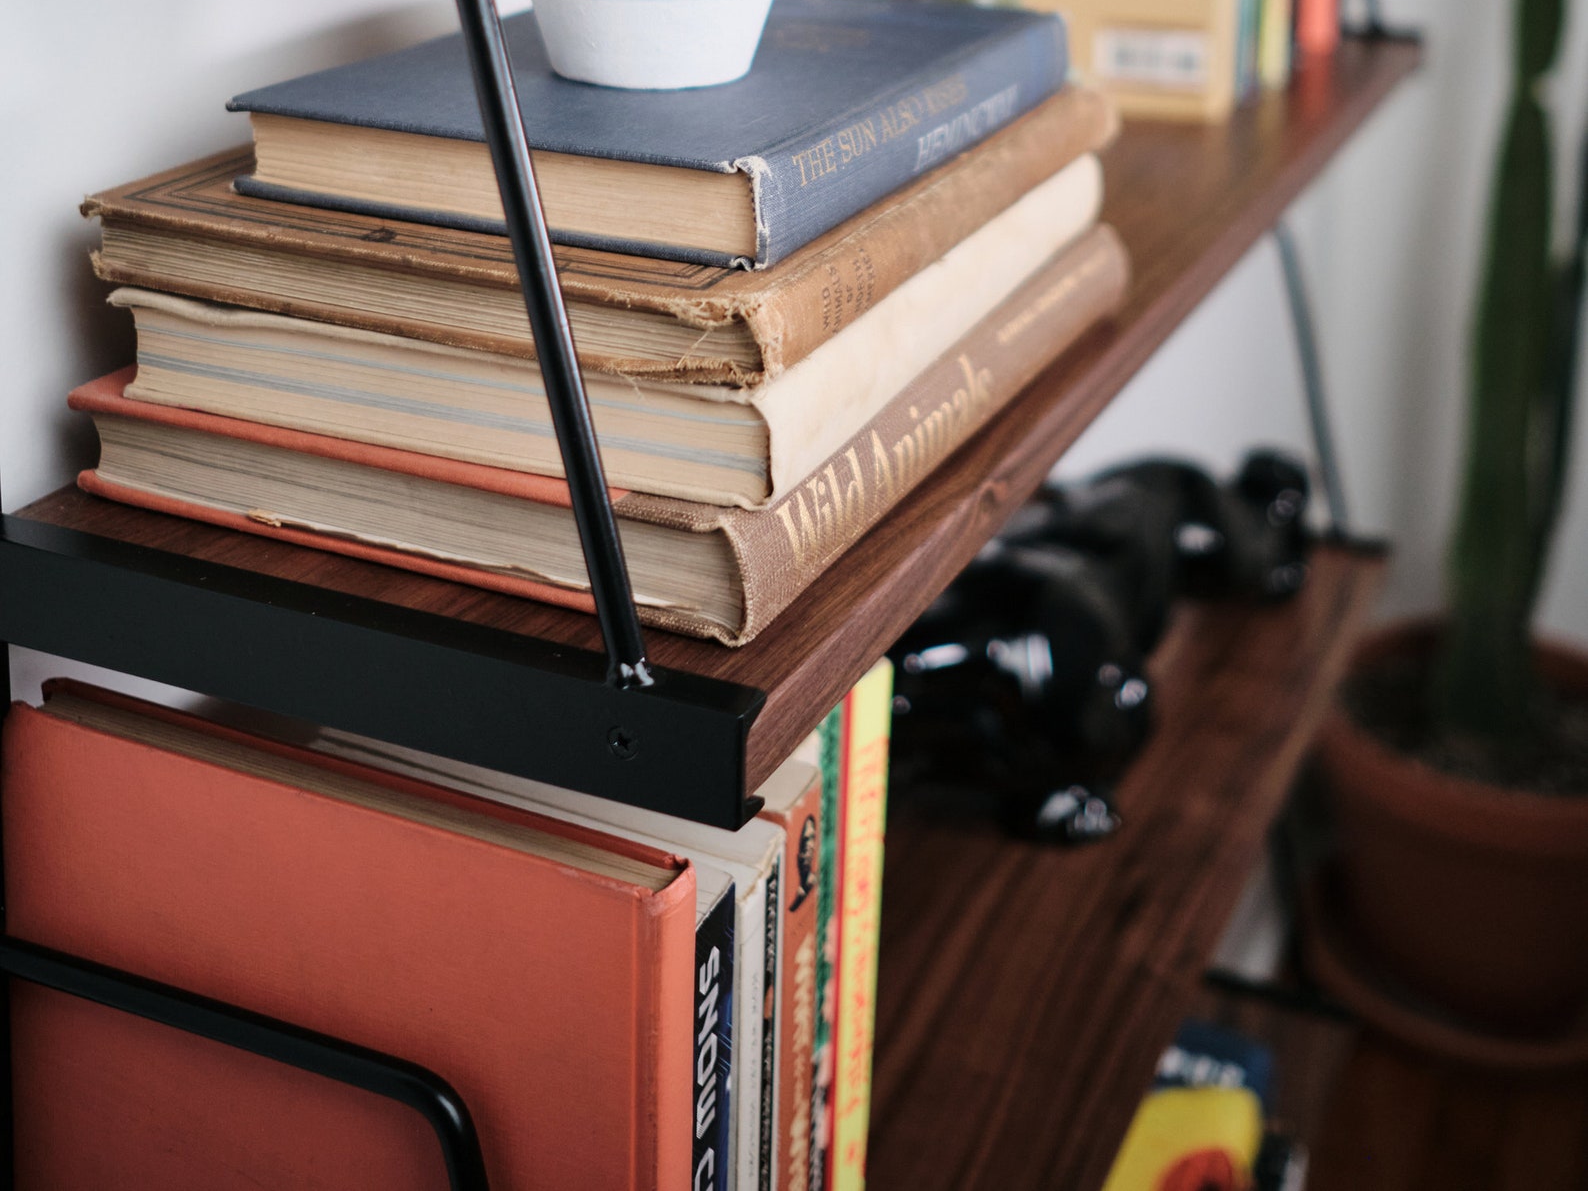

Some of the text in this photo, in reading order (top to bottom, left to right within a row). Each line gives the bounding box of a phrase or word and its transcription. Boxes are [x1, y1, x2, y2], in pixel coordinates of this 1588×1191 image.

[792, 137, 837, 186] THE
[838, 117, 877, 164] SUN
[880, 95, 923, 144] ALSO
[822, 287, 831, 331] WILD
[830, 265, 843, 334] ANIMALS
[845, 284, 854, 304] OF
[776, 353, 993, 569] Wild Animals
[695, 945, 720, 1140] SNOW
